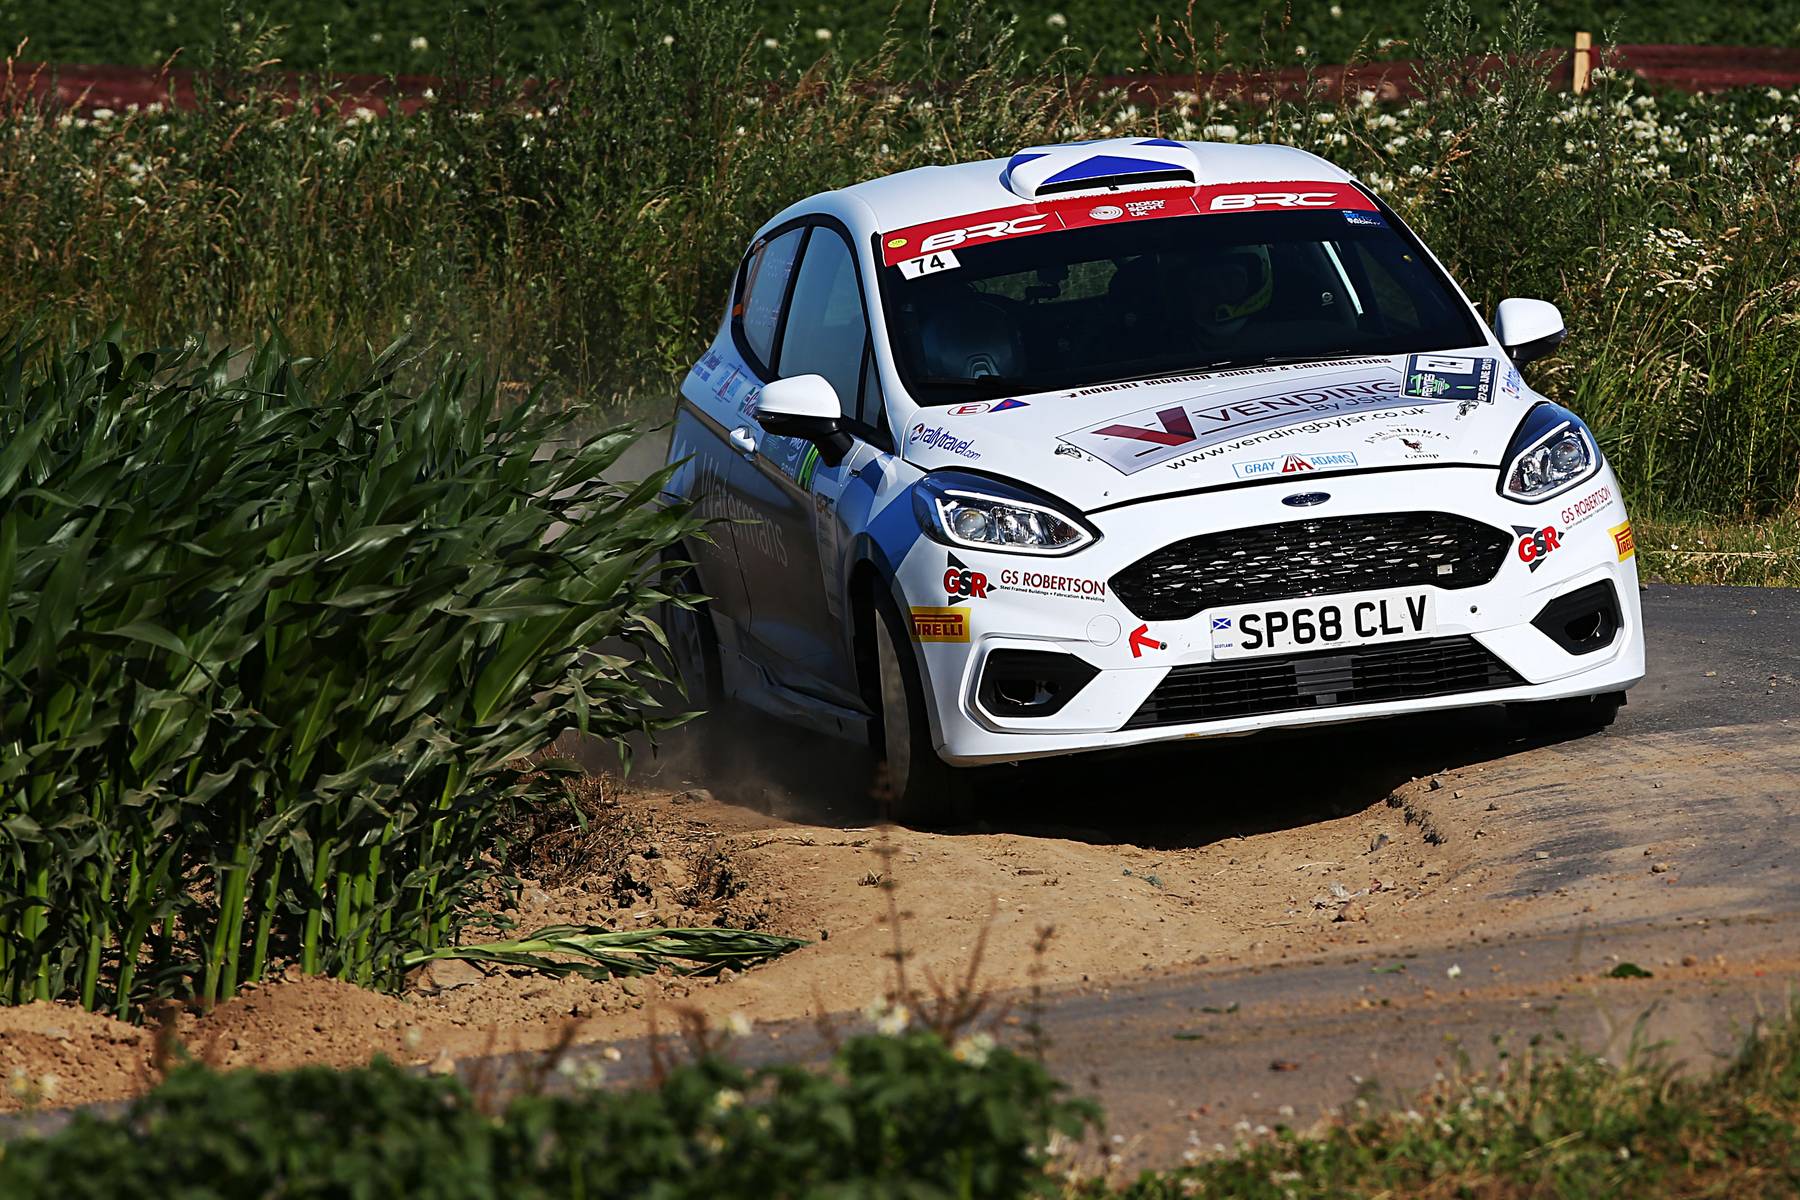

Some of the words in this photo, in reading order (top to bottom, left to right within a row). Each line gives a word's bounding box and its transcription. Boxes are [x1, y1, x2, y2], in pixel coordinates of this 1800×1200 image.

[1125, 200, 1166, 208] motor
[1128, 205, 1166, 213] sport
[1209, 192, 1338, 211] BRC
[920, 213, 1049, 253] BRC
[911, 254, 946, 274] 74
[1079, 382, 1141, 396] ROBERT
[1144, 374, 1212, 386] MORTON
[1217, 367, 1276, 378] JOINERS
[1293, 358, 1392, 371] CONTRACTORS
[1196, 381, 1401, 422] VENDING
[1346, 395, 1392, 406] JSR
[919, 426, 982, 461] rallytravel.com
[1166, 407, 1430, 470] www.vendingbyjsr.co.uk
[1244, 461, 1276, 475] GRAY
[1310, 453, 1355, 466] ADAMS
[1561, 507, 1576, 524] GS
[1574, 484, 1612, 517] ROBERTSON
[1518, 525, 1561, 563] GSR
[943, 568, 988, 599] GSR
[1000, 569, 1019, 585] GS
[1023, 571, 1105, 596] ROBERTSON
[1028, 588, 1049, 596] Buildings
[1238, 605, 1342, 650] SP68
[1354, 594, 1427, 638] CLV
